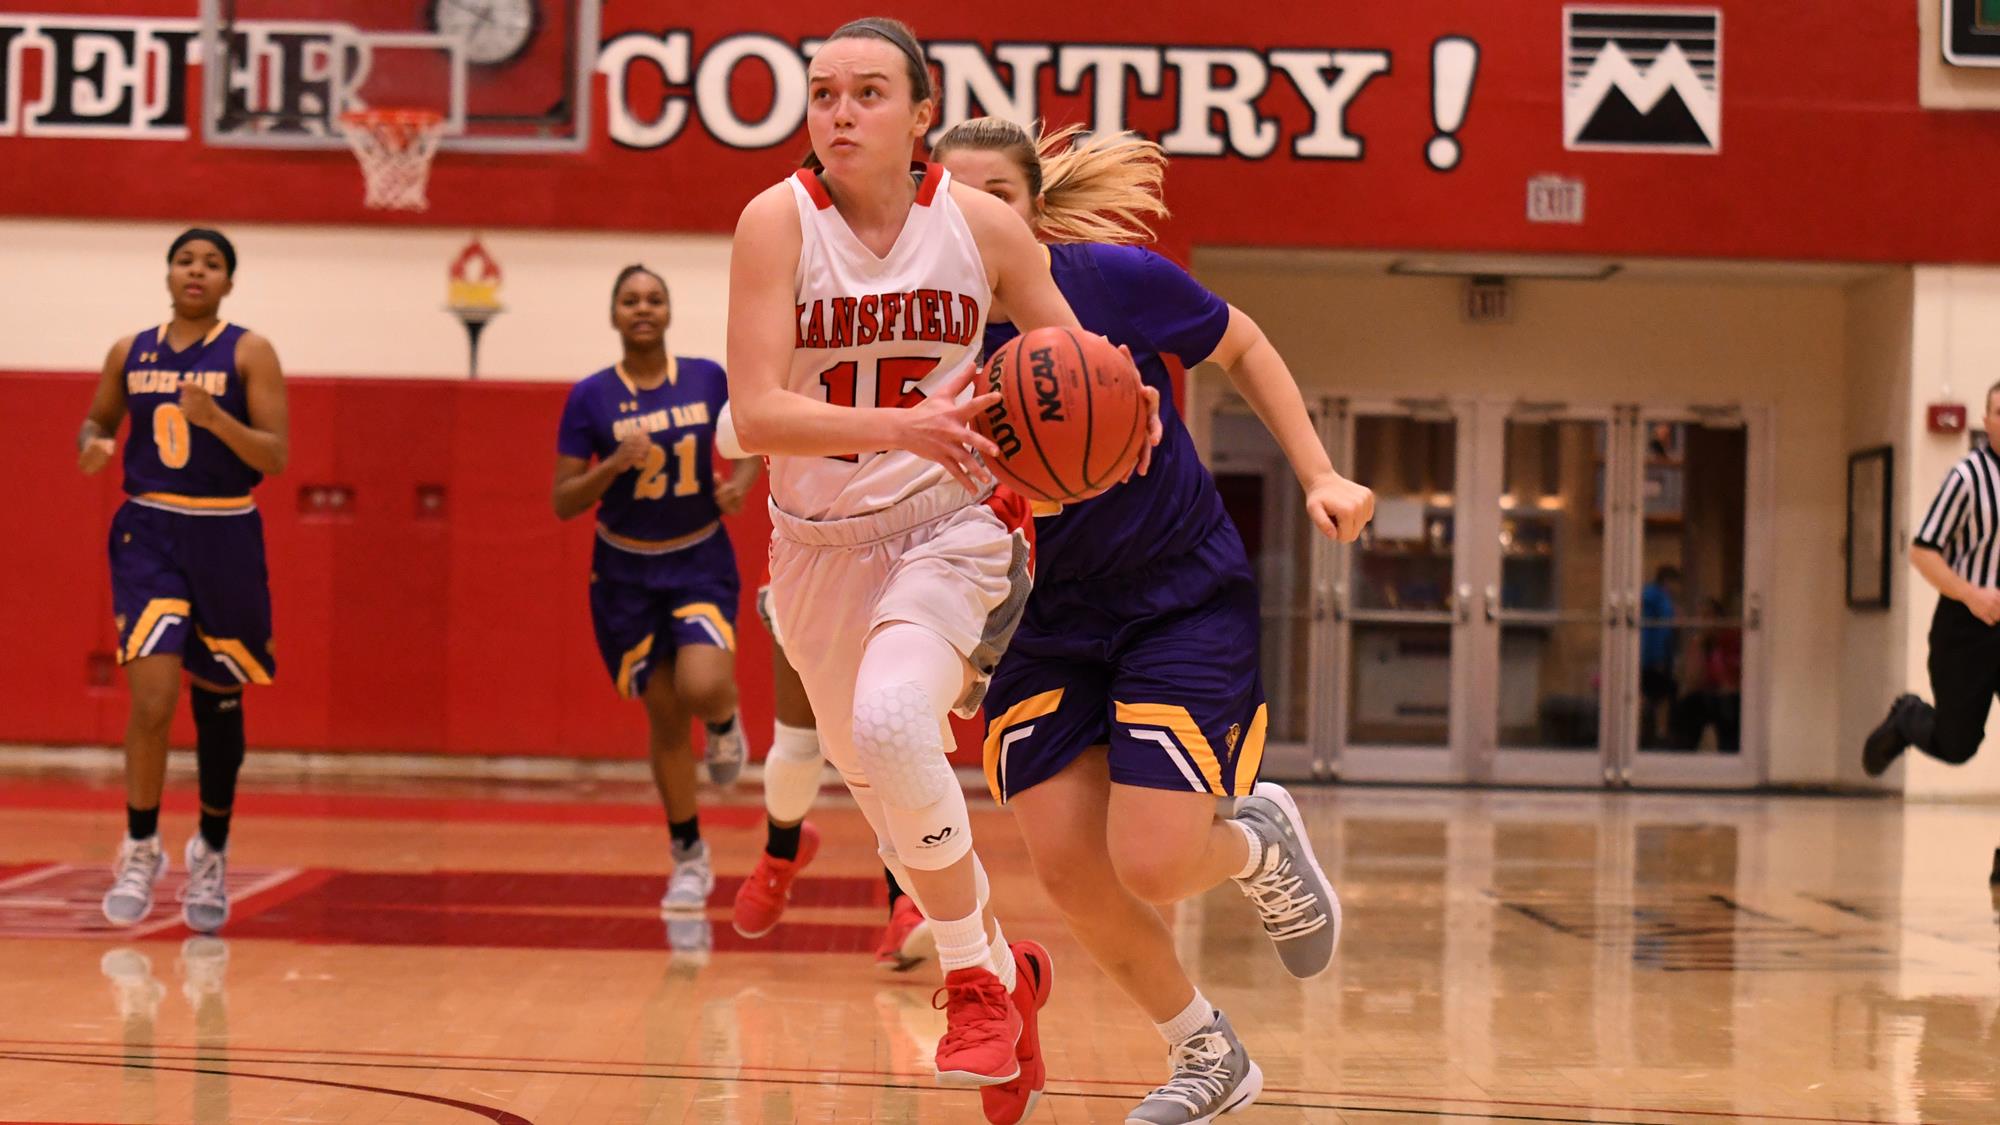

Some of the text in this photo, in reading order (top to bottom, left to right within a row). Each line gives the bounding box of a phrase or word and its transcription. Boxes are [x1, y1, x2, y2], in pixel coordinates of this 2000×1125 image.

[0, 16, 374, 140] EER
[597, 31, 1391, 160] CONTRY
[1029, 346, 1065, 423] NCAA
[153, 402, 190, 469] 0
[633, 432, 701, 501] 21
